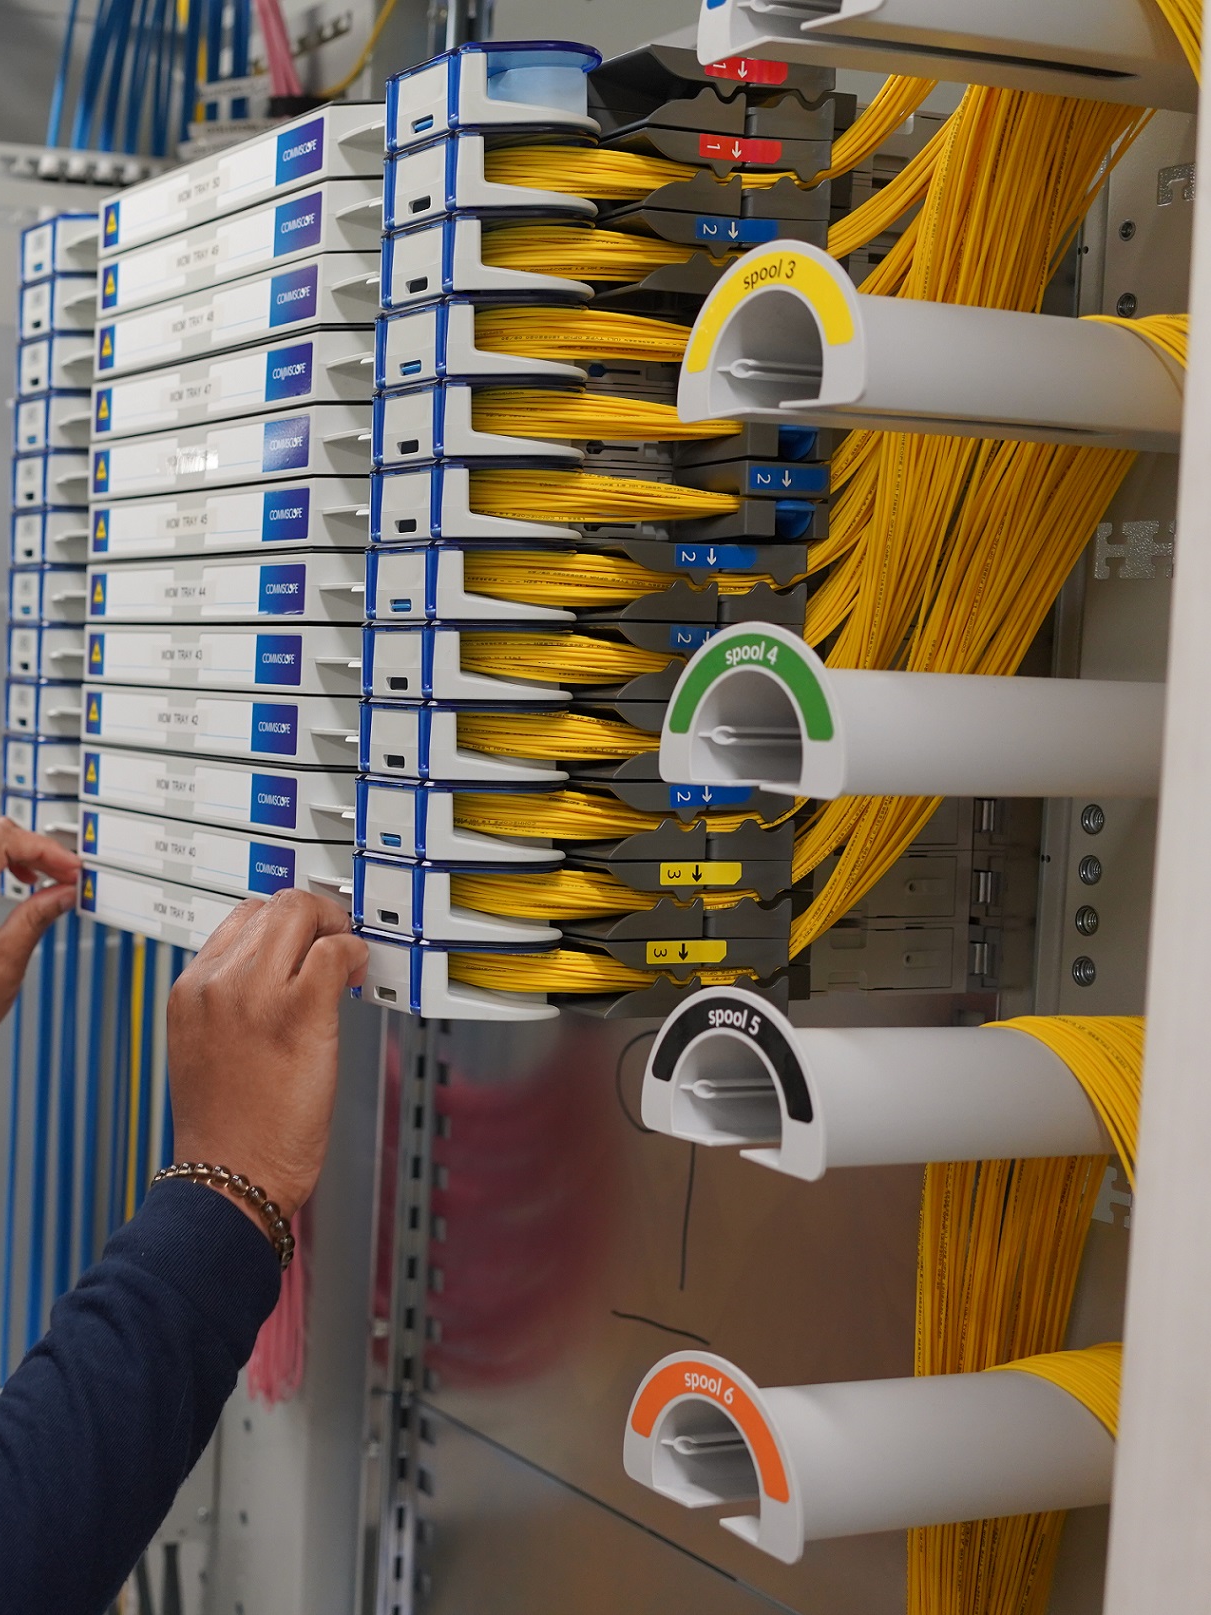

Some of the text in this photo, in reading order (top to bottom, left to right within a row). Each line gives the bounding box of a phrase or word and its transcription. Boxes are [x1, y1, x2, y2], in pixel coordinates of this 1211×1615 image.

[282, 138, 317, 163] COMMSCOPE
[706, 142, 721, 150] 1
[280, 212, 316, 234] COMMSCOPE
[702, 223, 718, 235] 2
[742, 258, 797, 290] spool 3
[276, 284, 311, 306] COMMSCOPE
[272, 362, 307, 382] COMMSCOPE
[204, 384, 212, 394] 47
[269, 435, 304, 452] COMMSCOPE
[757, 473, 771, 484] 2
[200, 514, 208, 525] 45
[269, 507, 303, 521] COMMSCOPE
[681, 551, 696, 562] 2
[198, 587, 206, 596] 44
[265, 582, 299, 595] COMMSCOPE
[677, 632, 692, 644] 2
[262, 652, 295, 666] COMMSCOPE
[725, 641, 779, 666] spool 4
[191, 714, 199, 726] 42
[258, 721, 291, 735] COMMSCOPE
[188, 783, 195, 792] 41
[257, 792, 290, 808] COMMSCOPE
[676, 791, 691, 802] 2
[255, 861, 289, 879] COMMSCOPE
[667, 869, 681, 879] 3
[653, 948, 667, 958] 3
[708, 1008, 762, 1036] spool 5
[684, 1371, 734, 1405] spool 6
